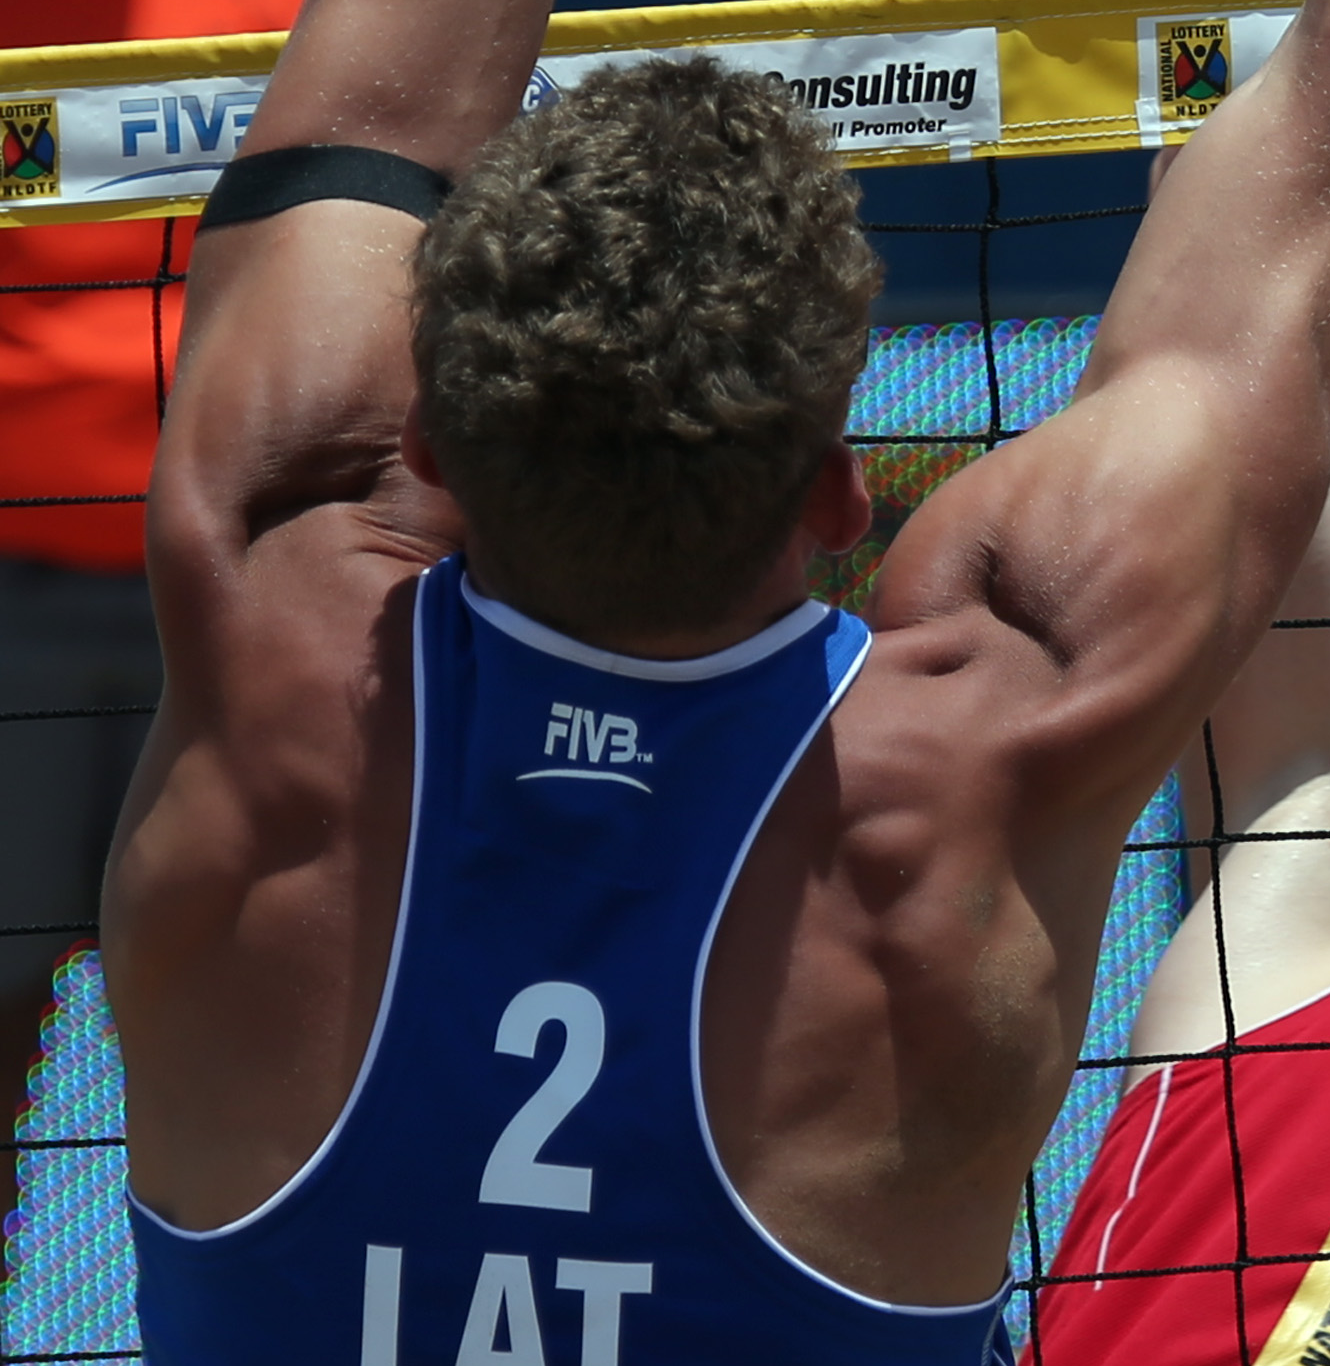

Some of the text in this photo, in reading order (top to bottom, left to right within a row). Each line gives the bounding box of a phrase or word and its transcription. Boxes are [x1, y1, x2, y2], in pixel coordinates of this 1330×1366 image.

[1171, 24, 1226, 40] LOTTERY
[1160, 39, 1174, 102] NATIONAL
[0, 103, 52, 119] LOTTERY
[1176, 103, 1217, 117] NLD
[851, 117, 947, 138] Promoter
[3, 182, 57, 196] NLDTF
[544, 702, 638, 764] FIVB
[478, 980, 606, 1213] 2
